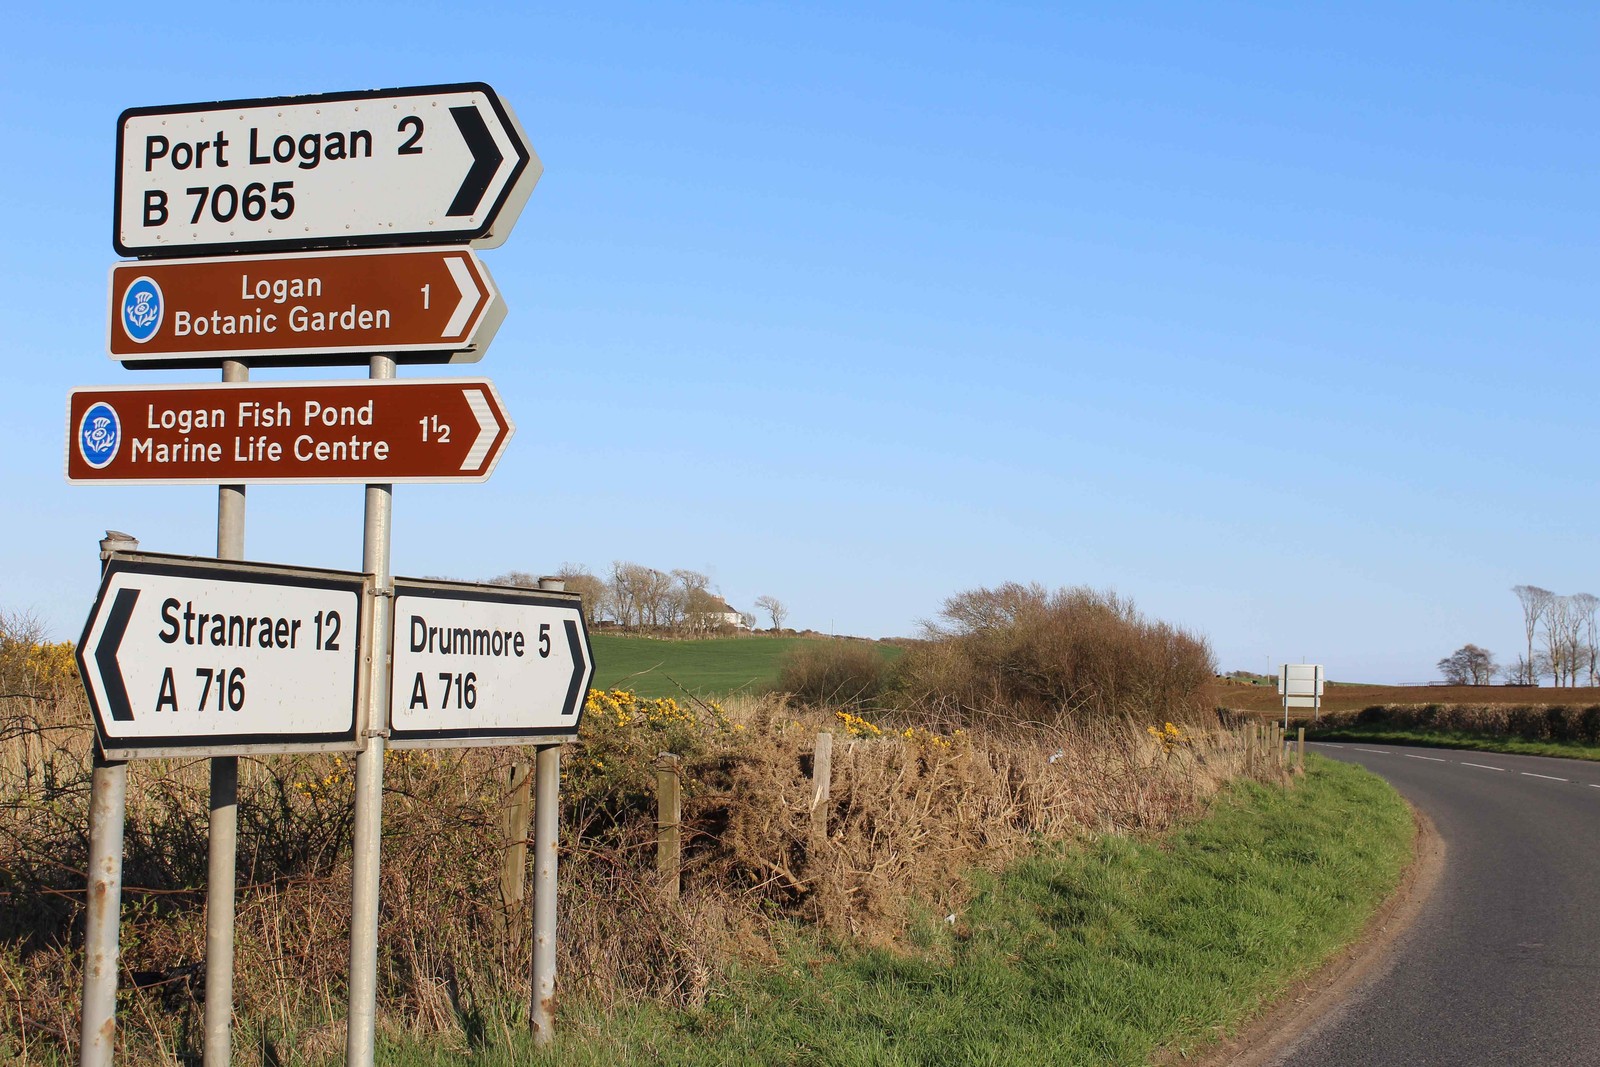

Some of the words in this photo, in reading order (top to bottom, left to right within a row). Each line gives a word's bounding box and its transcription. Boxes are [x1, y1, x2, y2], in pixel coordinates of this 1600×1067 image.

[146, 131, 228, 171] Port
[250, 128, 372, 169] Logan
[398, 116, 424, 155] 2
[143, 190, 168, 227] B
[187, 181, 294, 224] 7065
[242, 275, 321, 303] Logan
[421, 284, 429, 309] 1
[175, 308, 277, 335] Botanic
[289, 305, 389, 332] Garden
[148, 405, 224, 433] Logan
[239, 402, 290, 427] Fish
[305, 400, 372, 426] Pond
[132, 438, 221, 462] Marine
[235, 436, 281, 461] Life
[294, 435, 389, 461] Centre
[159, 598, 301, 648] Stranraer
[315, 611, 340, 650] 12
[411, 615, 524, 657] Drummore
[539, 624, 550, 658] 5
[156, 667, 178, 711] A
[196, 667, 245, 711] 716
[410, 672, 428, 709] A
[439, 672, 476, 709] 716
